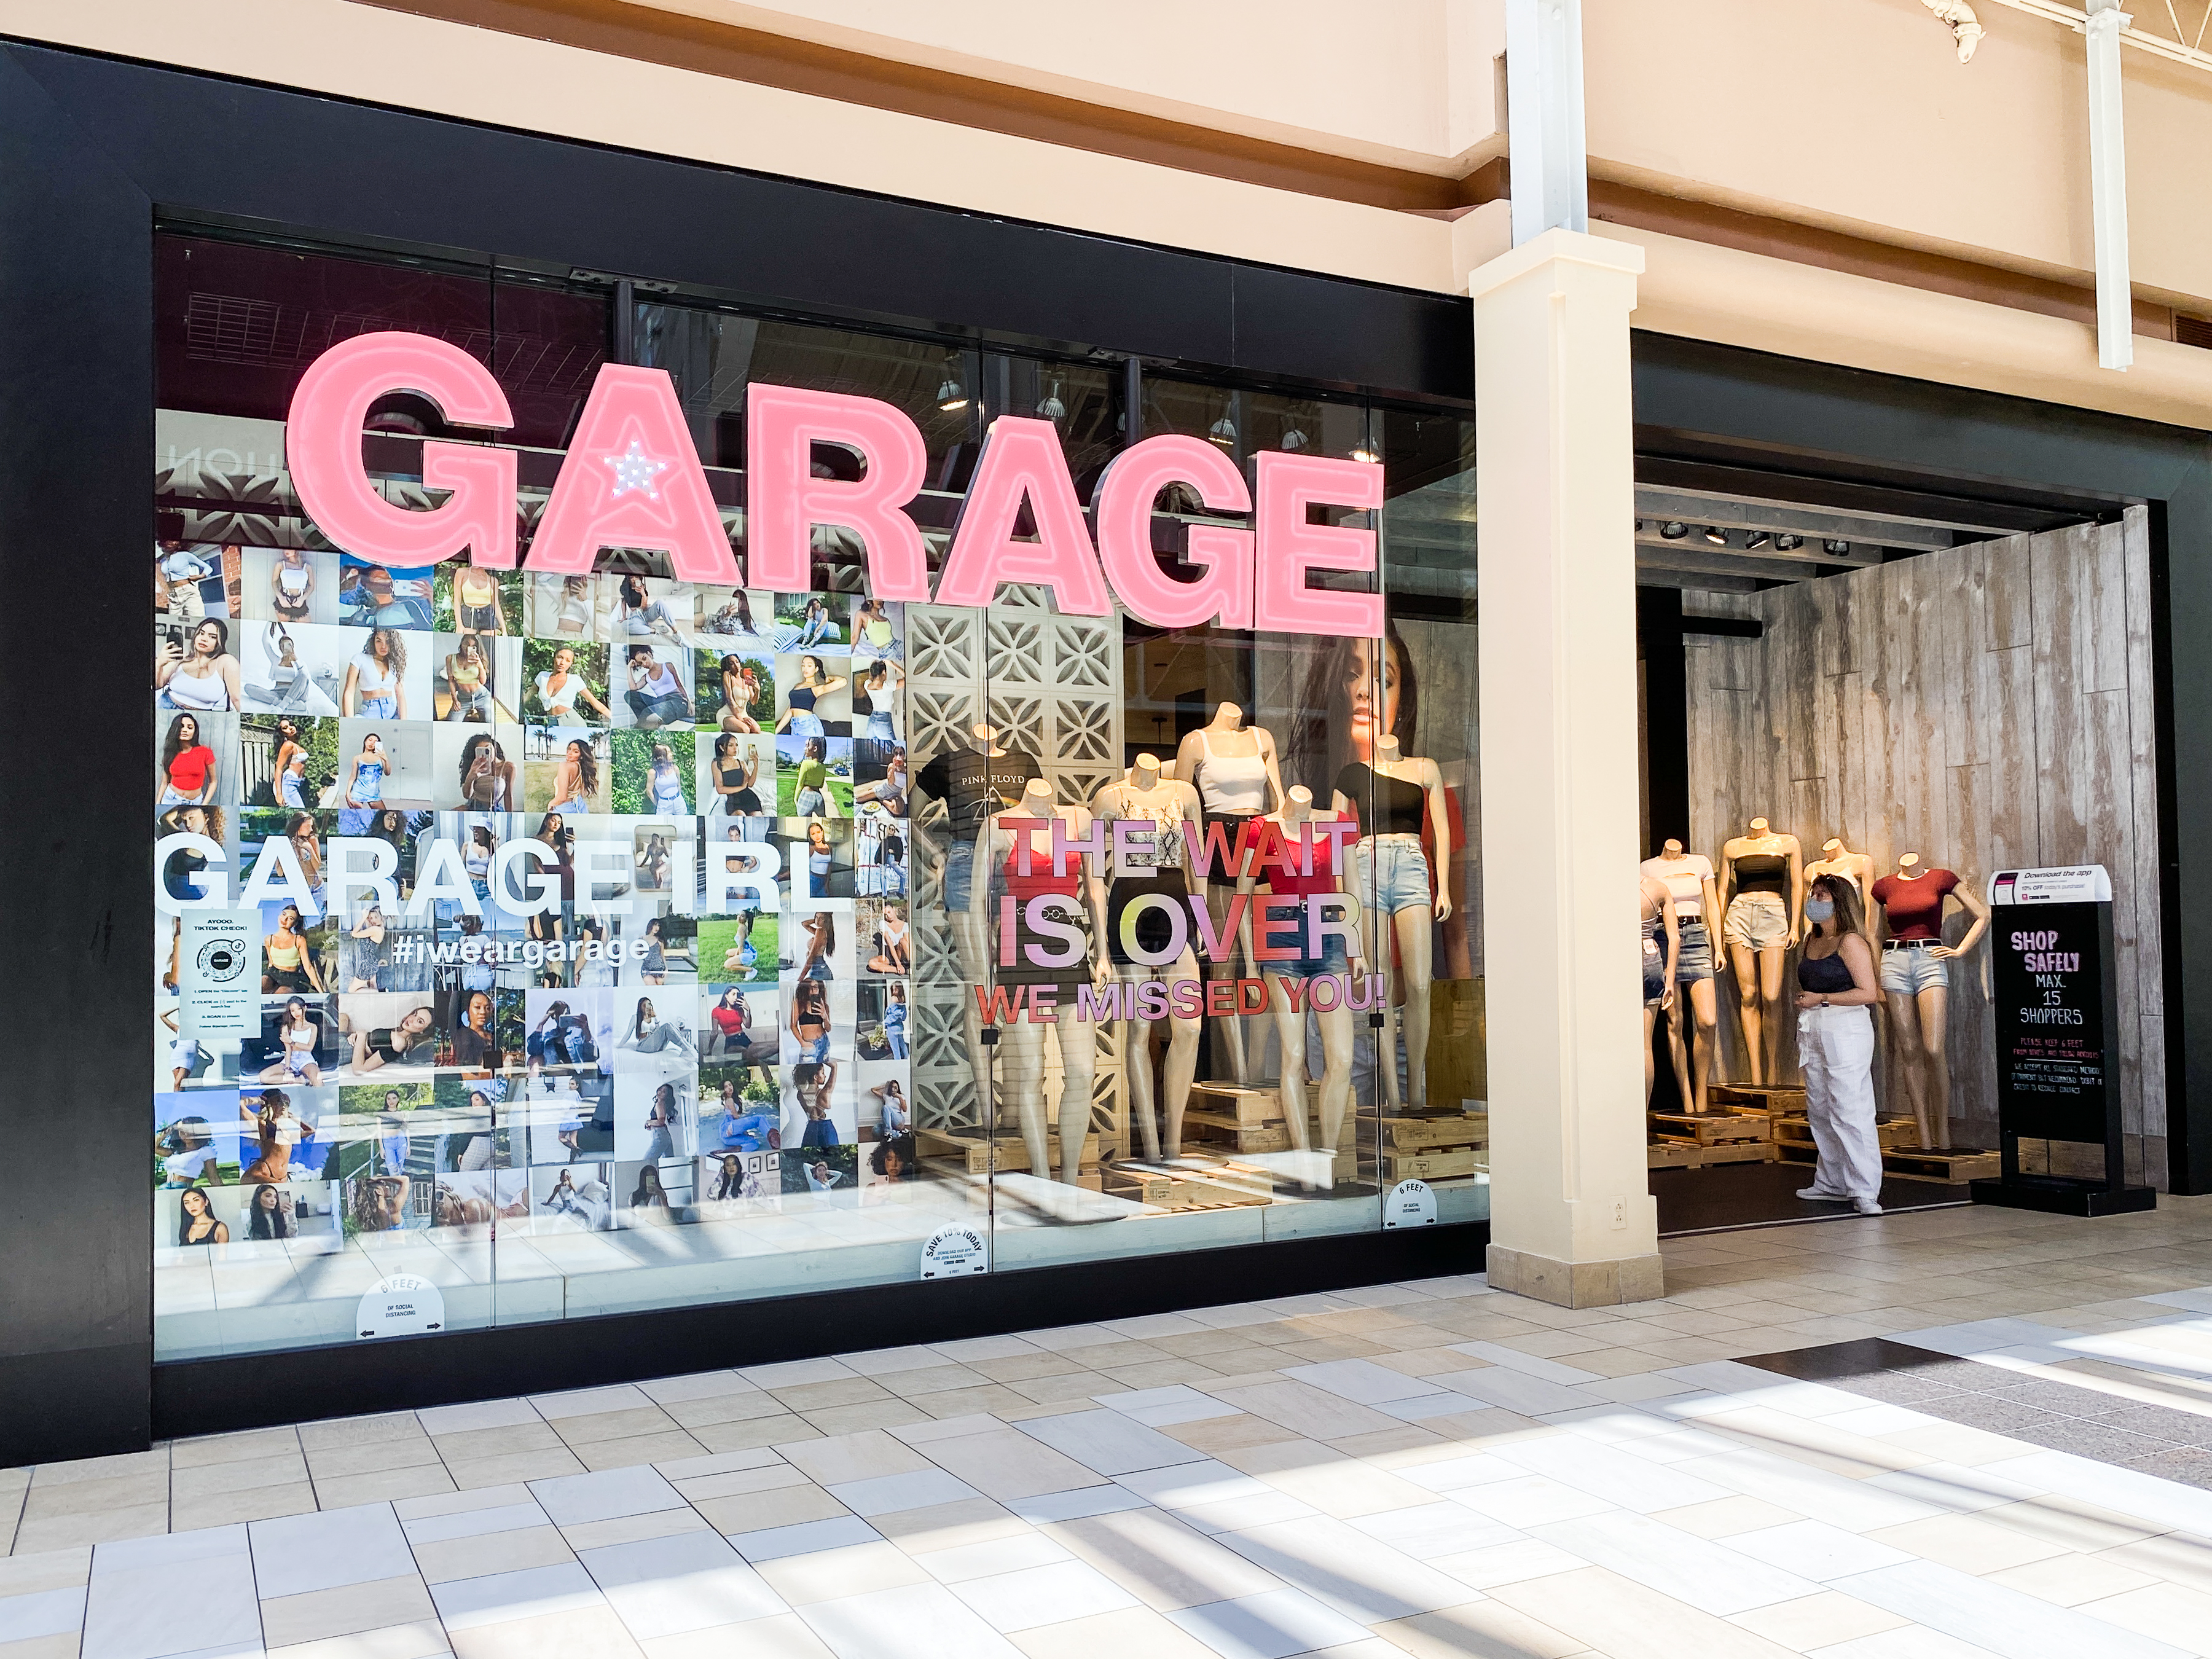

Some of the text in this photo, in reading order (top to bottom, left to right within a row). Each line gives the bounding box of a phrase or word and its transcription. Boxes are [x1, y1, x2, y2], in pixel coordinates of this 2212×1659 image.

[286, 331, 1385, 638] GARAGE
[962, 775, 1025, 786] PINK FLOYD
[998, 818, 1357, 878] THE WAIT
[155, 832, 852, 919] GARAGE IRL
[1000, 893, 1361, 968] IS OVER
[2010, 930, 2058, 951] SHOP
[393, 935, 649, 968] #iweargarage
[2024, 952, 2080, 972] SAFELY
[975, 973, 1386, 1025] WE MISSED YOU!
[2043, 991, 2061, 1005] 15
[2020, 1008, 2083, 1024] SHOPPERS
[2067, 1039, 2084, 1048] FEET
[1406, 1183, 1424, 1193] FEET
[926, 1228, 982, 1257] SAVE 10% TODAY
[380, 1279, 422, 1293] 6 FEET
